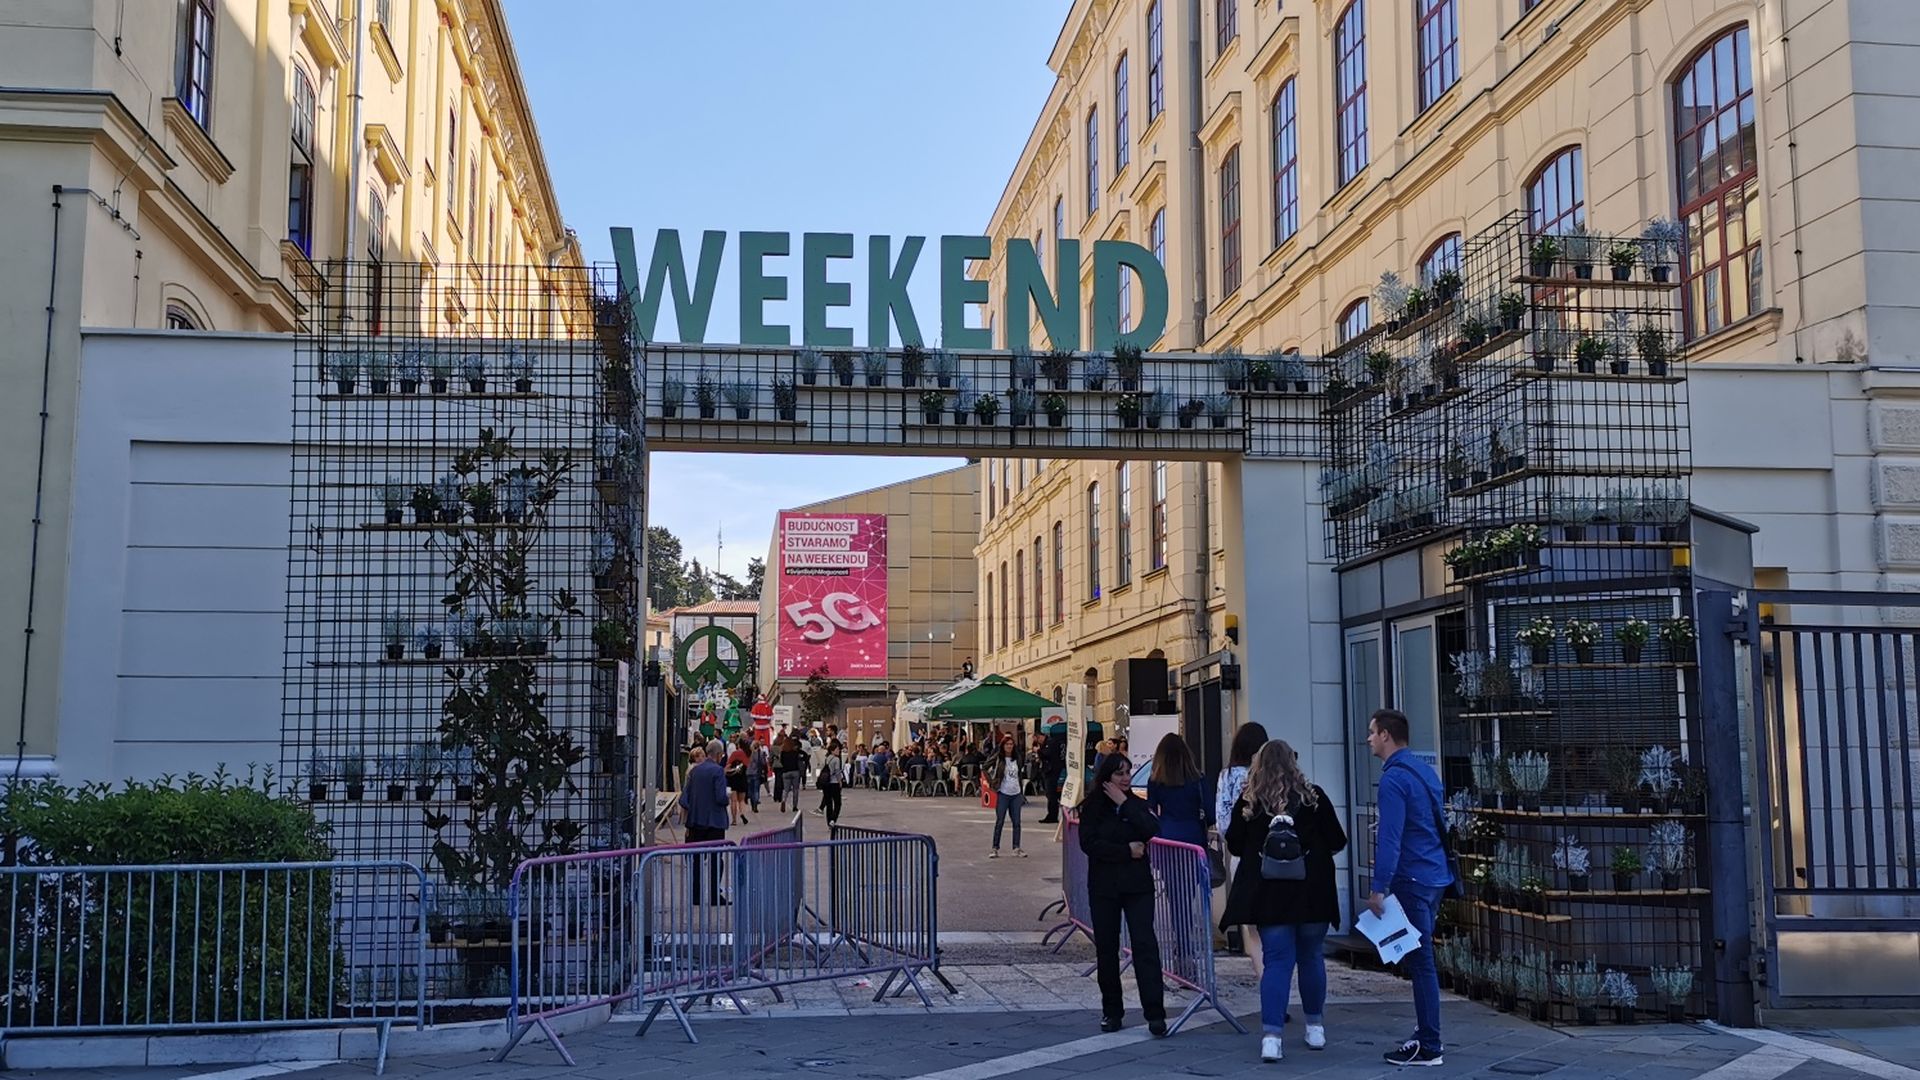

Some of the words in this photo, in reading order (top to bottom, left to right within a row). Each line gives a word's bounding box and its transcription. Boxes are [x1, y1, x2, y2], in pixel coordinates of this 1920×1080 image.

[610, 226, 1169, 351] WEEKEND
[788, 519, 855, 531] BUDUĆNOST
[787, 537, 847, 548] STVARAMO
[787, 553, 802, 564] NA
[804, 554, 866, 565] WEEKENDU
[784, 591, 881, 640] 5G
